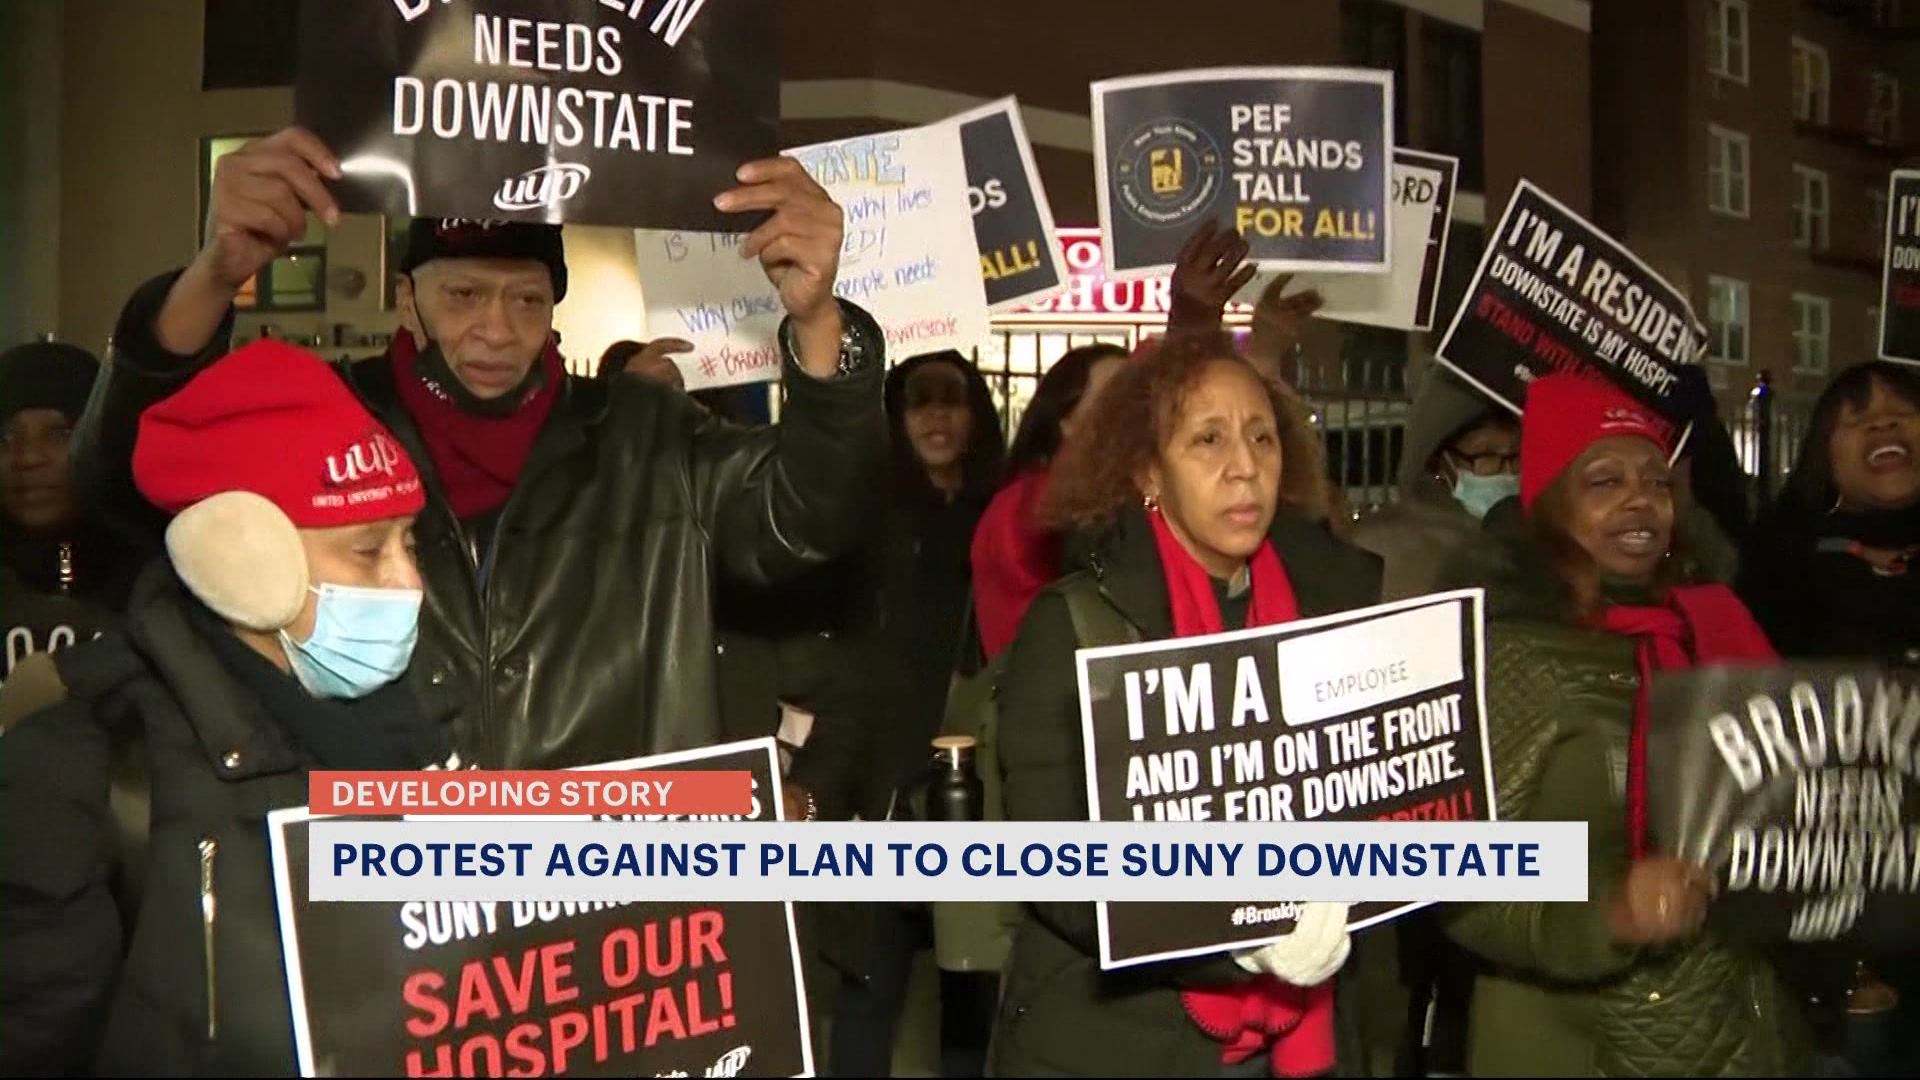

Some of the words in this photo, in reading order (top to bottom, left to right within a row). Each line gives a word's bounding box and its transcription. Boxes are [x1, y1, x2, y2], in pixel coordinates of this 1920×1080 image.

[473, 13, 623, 77] NEEDS
[393, 75, 694, 156] DOWNSTATE
[1230, 104, 1292, 132] PEF
[496, 165, 588, 208] uup
[1232, 139, 1363, 170] STANDS
[1233, 172, 1310, 204] TALL
[1236, 206, 1303, 239] FOR
[1313, 208, 1376, 242] ALL!
[1507, 207, 1564, 270] I'M
[1555, 243, 1586, 288] A
[1488, 253, 1588, 334] DOWNSTATE
[1582, 316, 1604, 346] IS
[1597, 329, 1629, 364] MY
[326, 433, 399, 483] uup
[1123, 662, 1215, 742] I'M
[1231, 655, 1270, 728] A
[1314, 659, 1409, 703] EMPLOYEE
[1125, 749, 1200, 799] AND
[1210, 740, 1264, 788] I'M
[1273, 730, 1319, 777] ON
[1323, 715, 1379, 765] THE
[1382, 693, 1462, 751] FRONT
[1225, 783, 1297, 822] FOR
[1302, 740, 1465, 820] DOWNSTATE.
[402, 940, 580, 1038] SAVE
[600, 909, 729, 990] OUR
